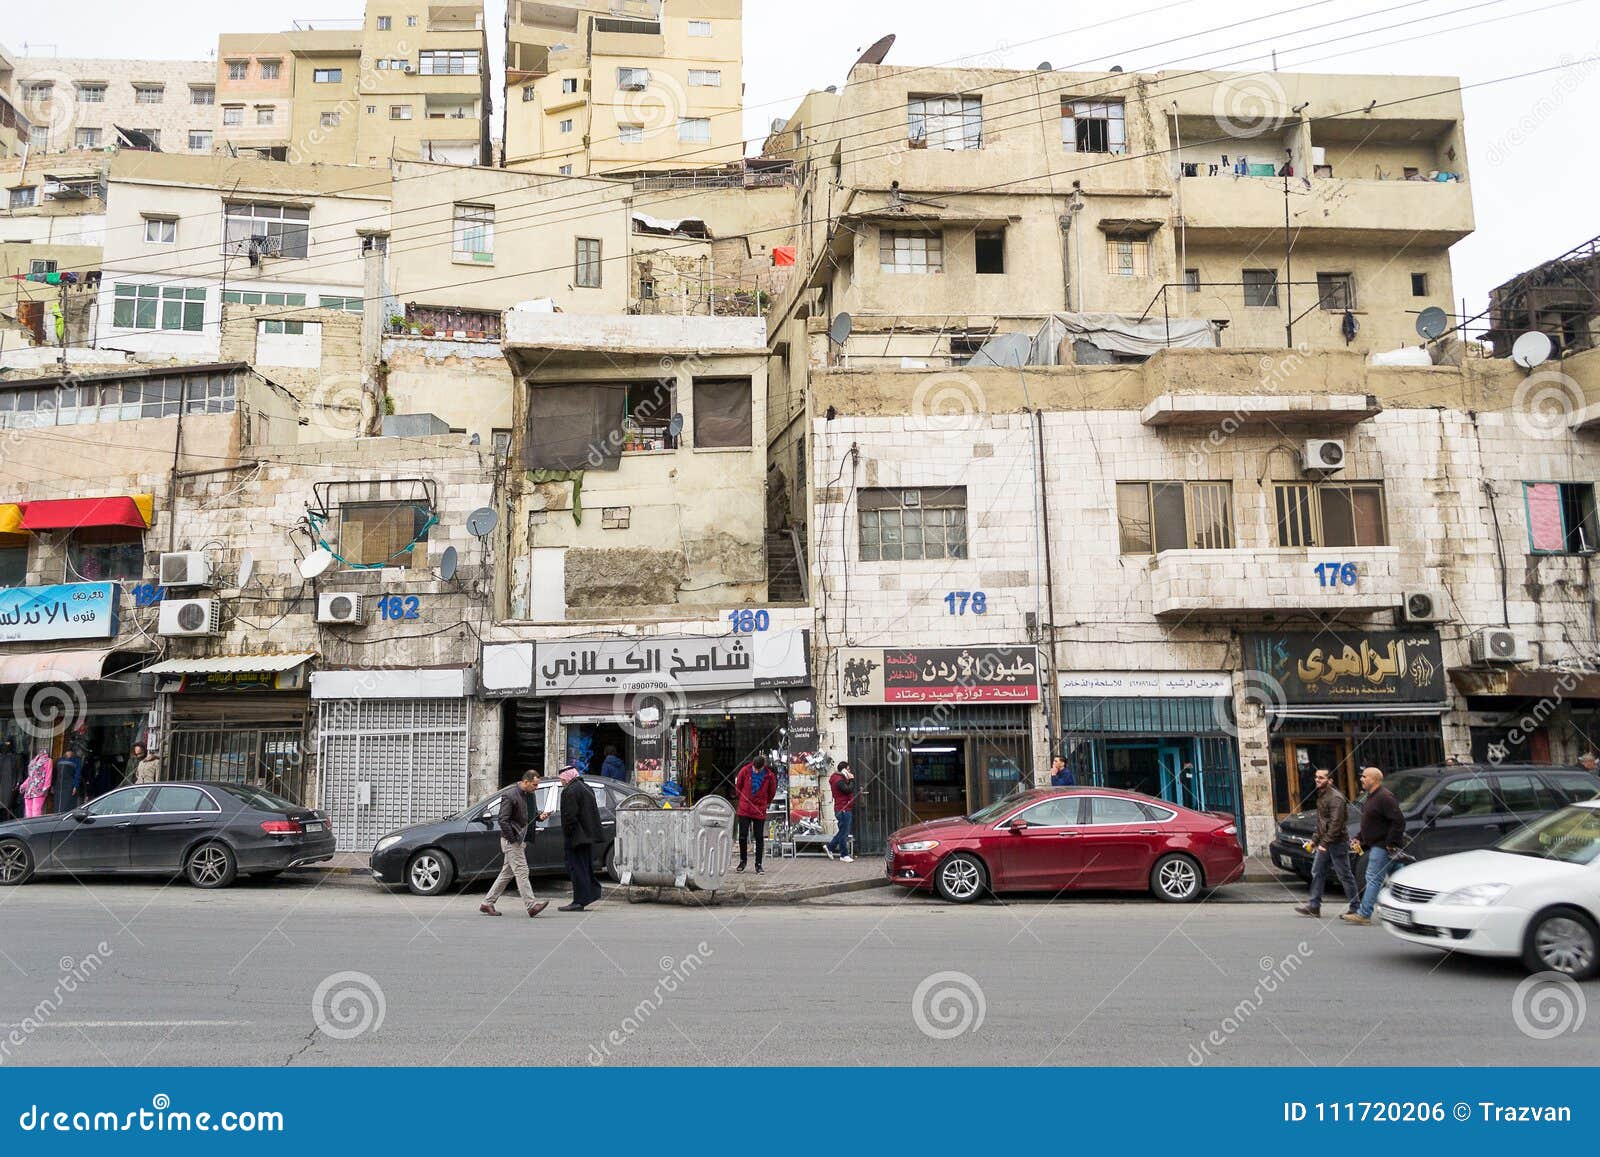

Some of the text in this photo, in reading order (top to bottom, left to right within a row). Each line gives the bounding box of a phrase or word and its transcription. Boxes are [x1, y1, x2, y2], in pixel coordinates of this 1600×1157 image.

[1313, 562, 1357, 587] 176
[377, 595, 420, 621] 182
[944, 591, 987, 616] 178
[728, 609, 770, 633] 180
[541, 639, 749, 687] شامخ الكيلاني
[982, 655, 1035, 681] طيور
[1298, 639, 1408, 695] الزاهري
[622, 682, 668, 690] 0789007900
[895, 690, 925, 701] وعتاد
[994, 687, 1029, 697] أسلحة
